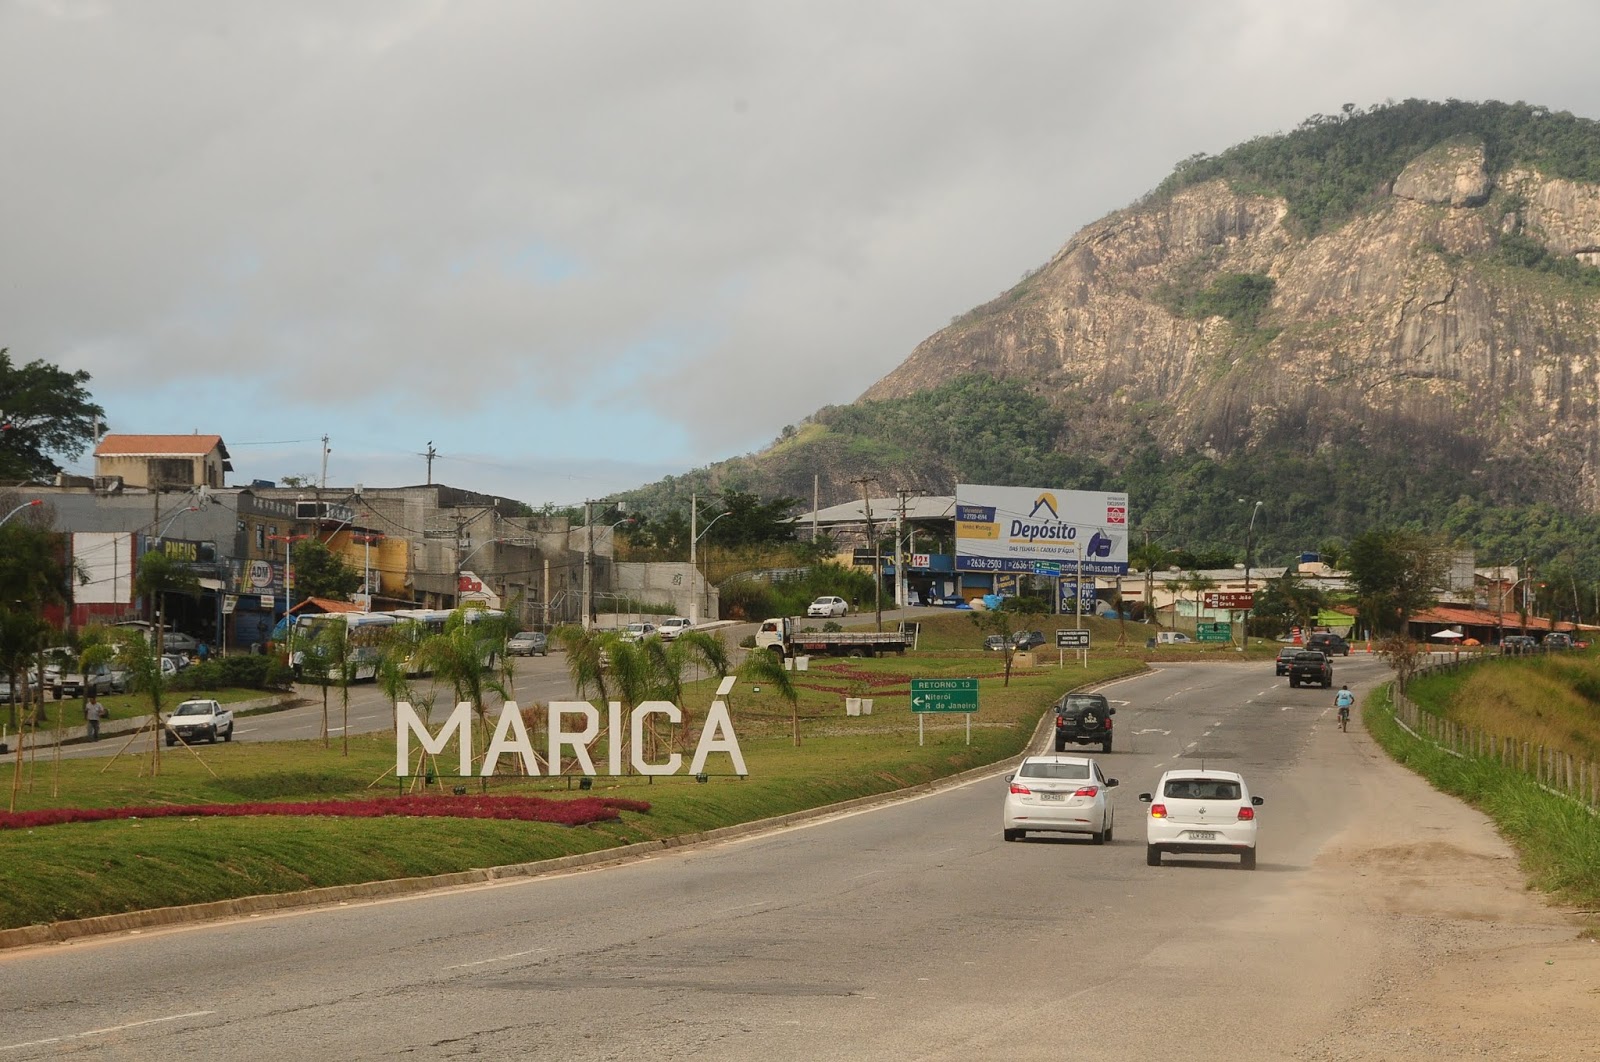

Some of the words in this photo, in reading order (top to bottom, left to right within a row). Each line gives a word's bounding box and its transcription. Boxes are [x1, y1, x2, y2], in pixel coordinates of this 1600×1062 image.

[1010, 519, 1076, 542] Depósito
[165, 541, 197, 561] PNEUS
[971, 559, 1002, 568] 2636-2503
[1012, 560, 1034, 569] 2636-15
[252, 566, 268, 578] ADM
[396, 676, 748, 776] MARICÁ
